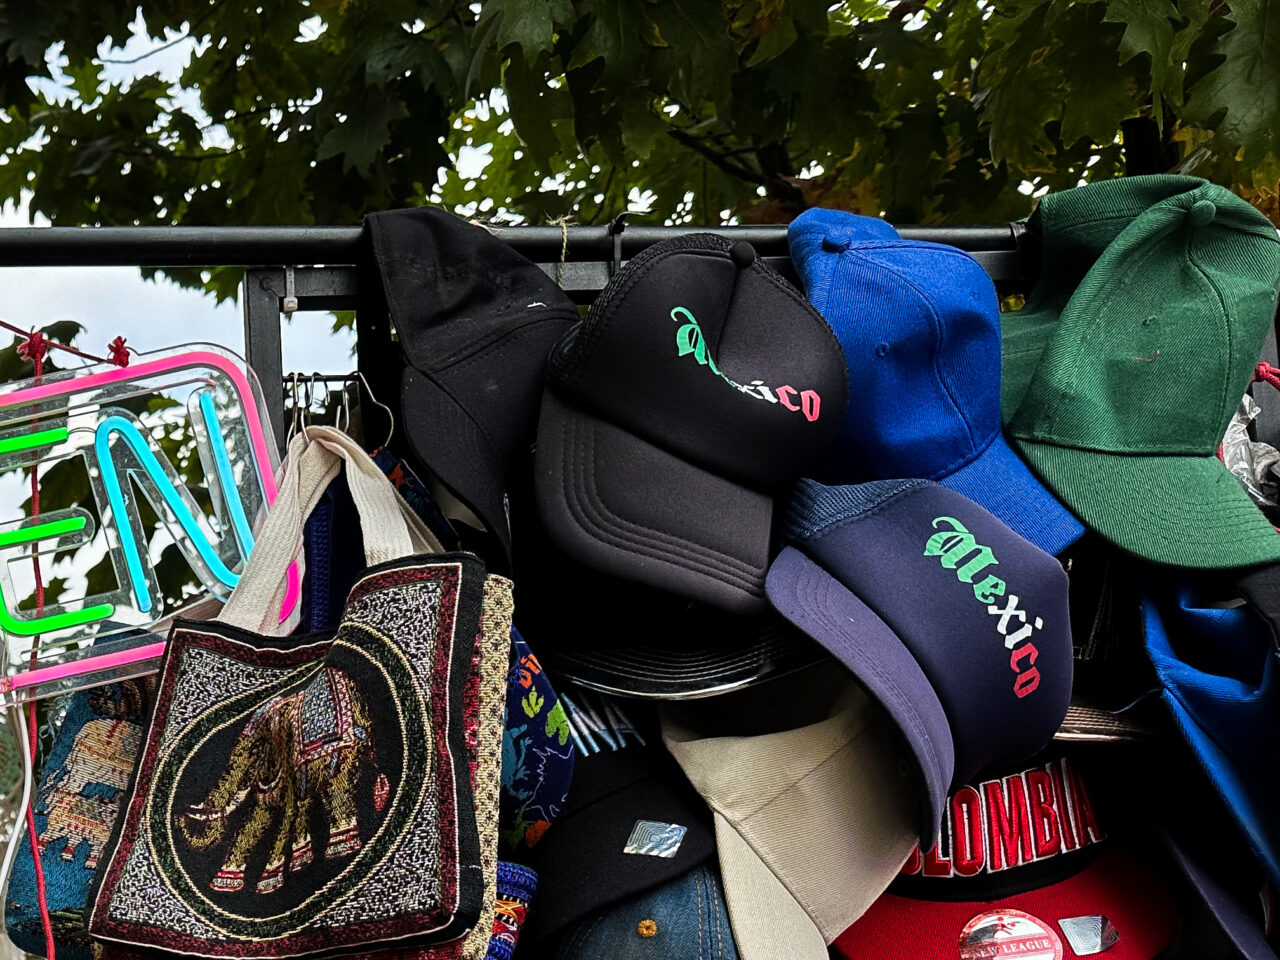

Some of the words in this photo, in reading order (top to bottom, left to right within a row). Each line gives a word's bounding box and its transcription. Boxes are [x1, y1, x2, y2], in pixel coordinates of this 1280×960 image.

[670, 306, 821, 422] Mxico
[923, 516, 1044, 699] Mexico
[900, 757, 1108, 879] LOMBIA
[1003, 939, 1052, 954] LEAGUE
